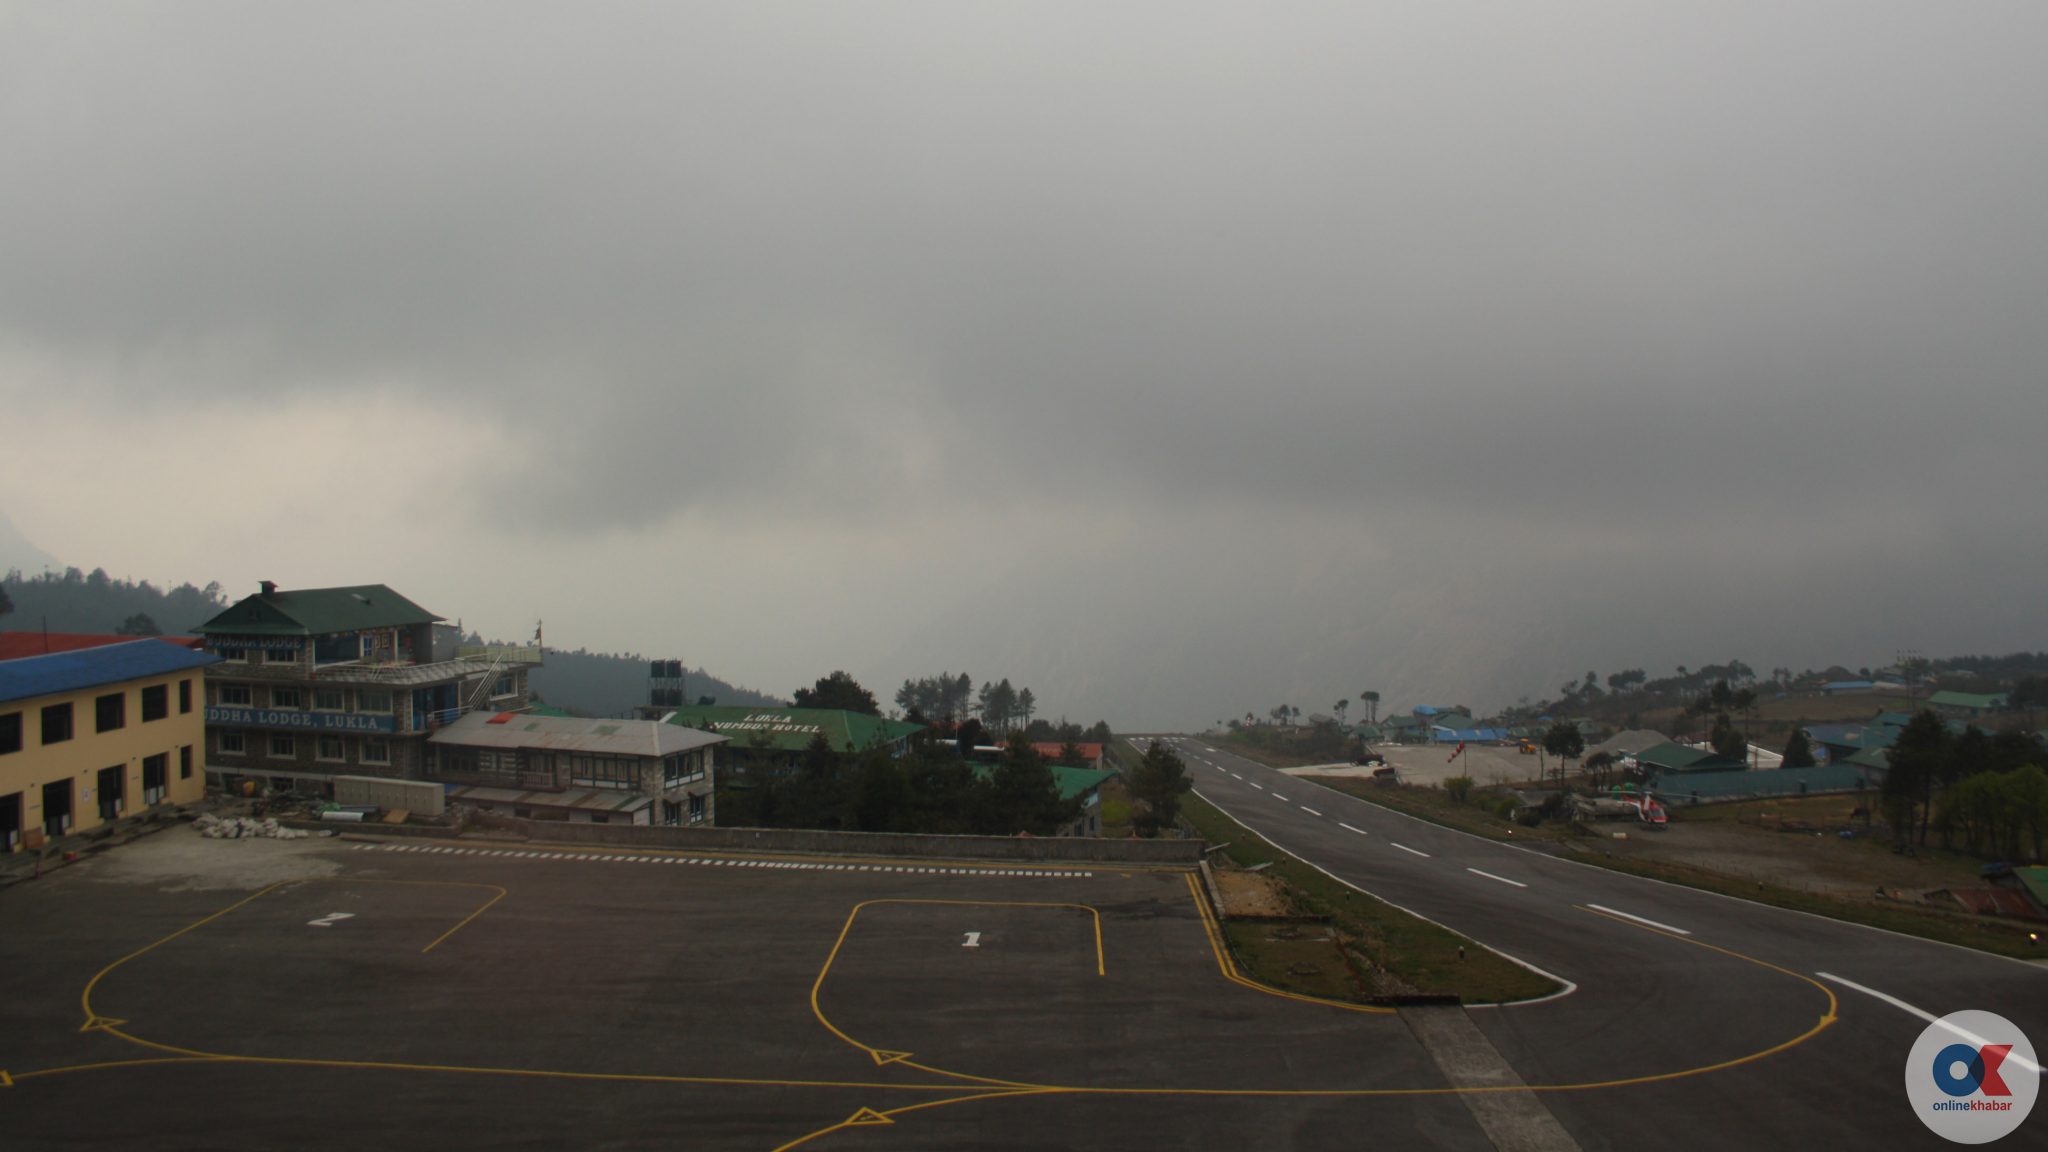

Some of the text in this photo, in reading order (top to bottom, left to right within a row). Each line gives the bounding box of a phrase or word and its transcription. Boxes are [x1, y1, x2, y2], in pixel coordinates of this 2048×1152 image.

[325, 714, 378, 729] LUKLA
[743, 713, 792, 723] LUKLA
[772, 724, 820, 733] HOTEL
[962, 931, 981, 947] 1
